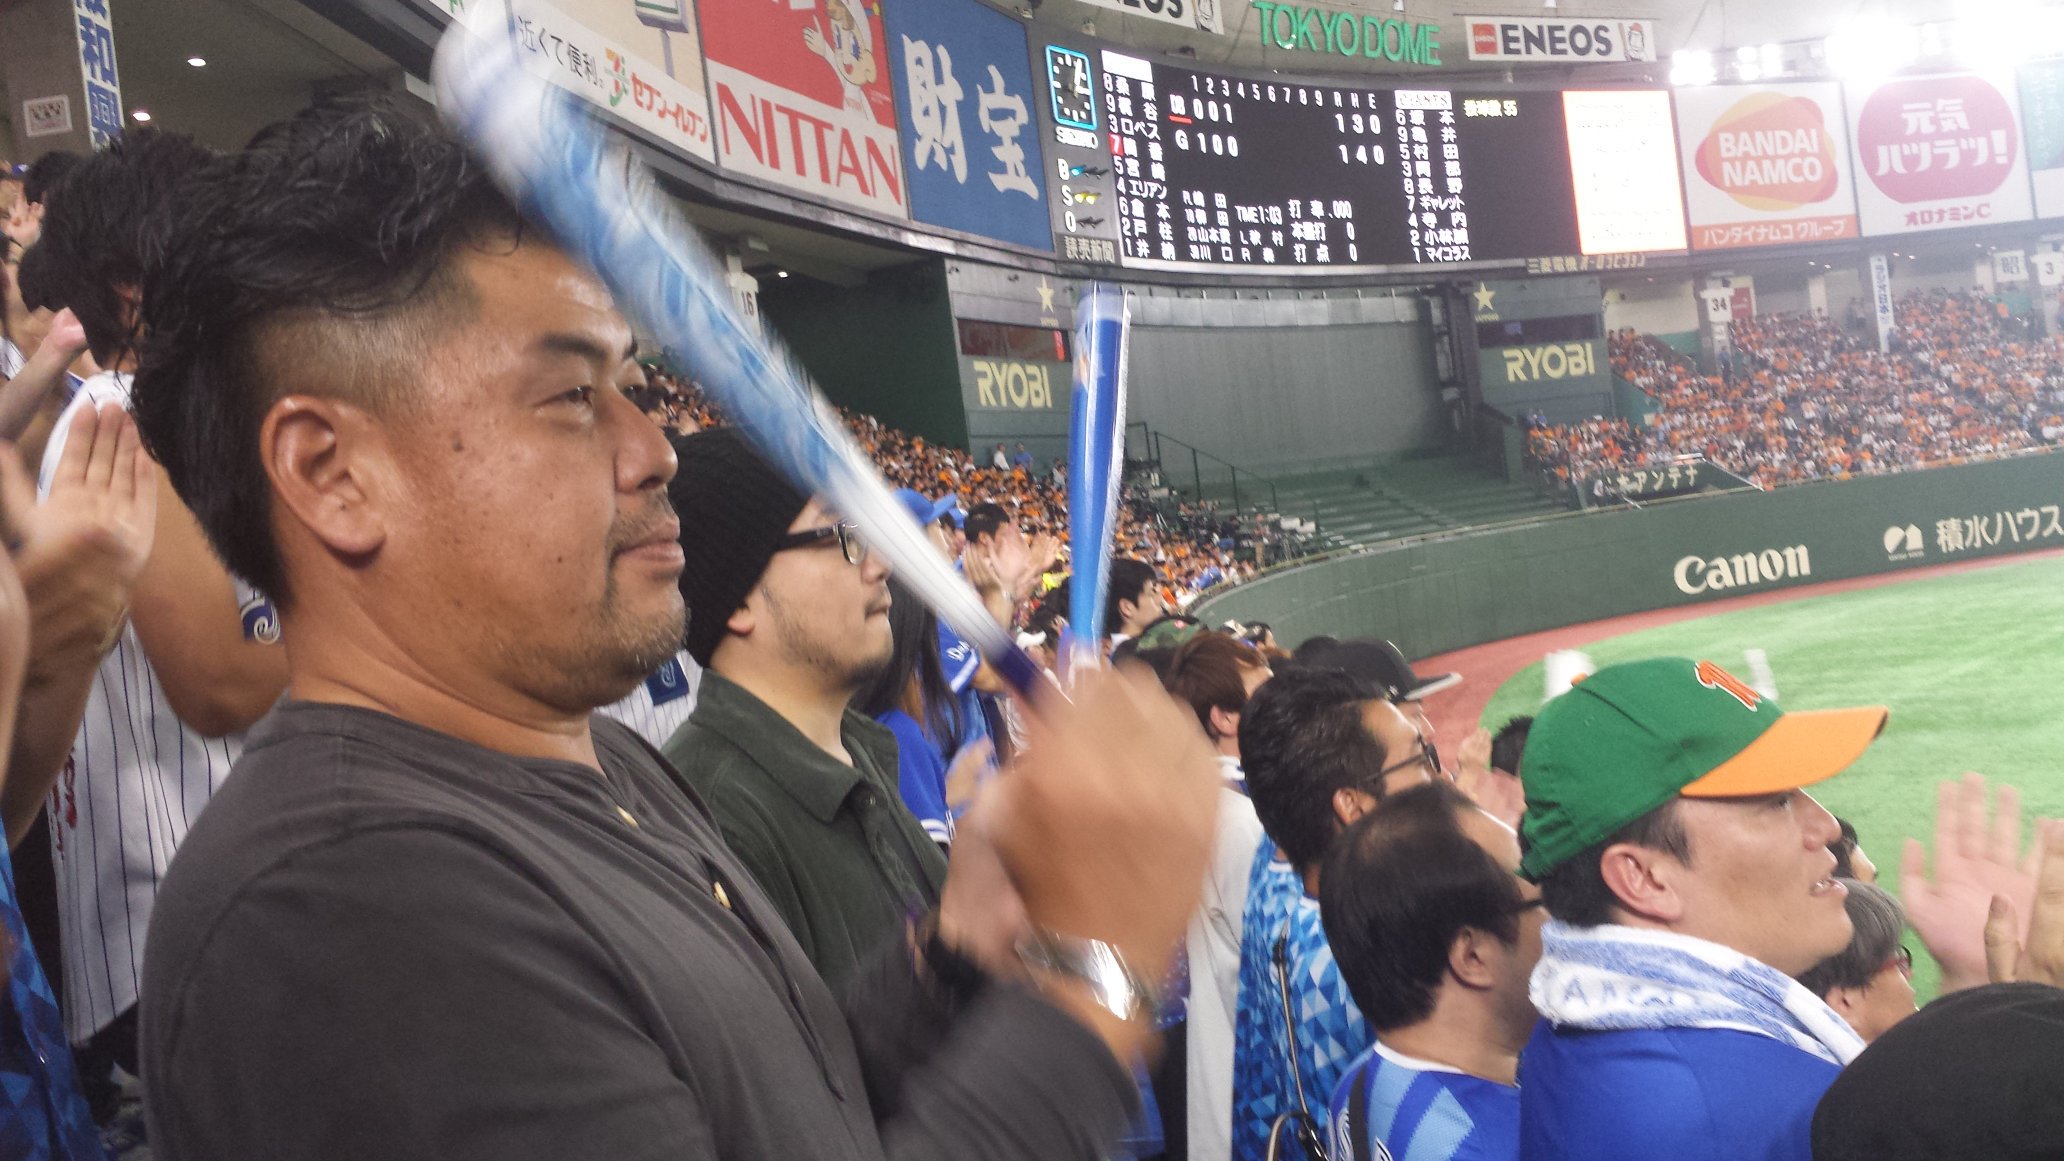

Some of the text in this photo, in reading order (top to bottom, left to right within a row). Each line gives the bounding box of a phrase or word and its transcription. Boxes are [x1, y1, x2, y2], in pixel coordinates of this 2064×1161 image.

[1253, 1, 1441, 66] TOKYO DOME
[1501, 24, 1613, 56] ENEOS
[1103, 73, 1113, 92] 8
[1191, 75, 1377, 109] 1 2 3 4 5 6 7 8 9 R H E
[1106, 93, 1116, 113] 9
[1108, 114, 1118, 134] 3
[1395, 109, 1406, 125] 6
[1900, 98, 1971, 136] 元気
[716, 81, 902, 206] NITTAN
[1175, 129, 1189, 150] G
[1397, 126, 1408, 142] 9
[1719, 128, 1819, 158] BANDAI
[1112, 134, 1121, 155] 7
[1400, 143, 1410, 160] 5
[1058, 158, 1069, 180] B
[1114, 156, 1124, 175] 5
[1402, 160, 1412, 177] 3
[1722, 157, 1823, 187] NAMCO
[1117, 177, 1167, 200] 4 エリアン
[1404, 177, 1414, 194] 8
[1062, 185, 1073, 207] S
[1119, 196, 1129, 216] 6
[1406, 195, 1415, 211] 7
[1121, 217, 1131, 236] 2
[1408, 212, 1418, 229] 4
[1125, 238, 1132, 256] 1
[1410, 229, 1421, 246] 2
[1413, 246, 1420, 263] 1
[1503, 342, 1595, 383] RYOBI
[973, 360, 1052, 409] RYOBI
[1936, 505, 2064, 553] 積水ハウス
[1674, 544, 1811, 595] Canon
